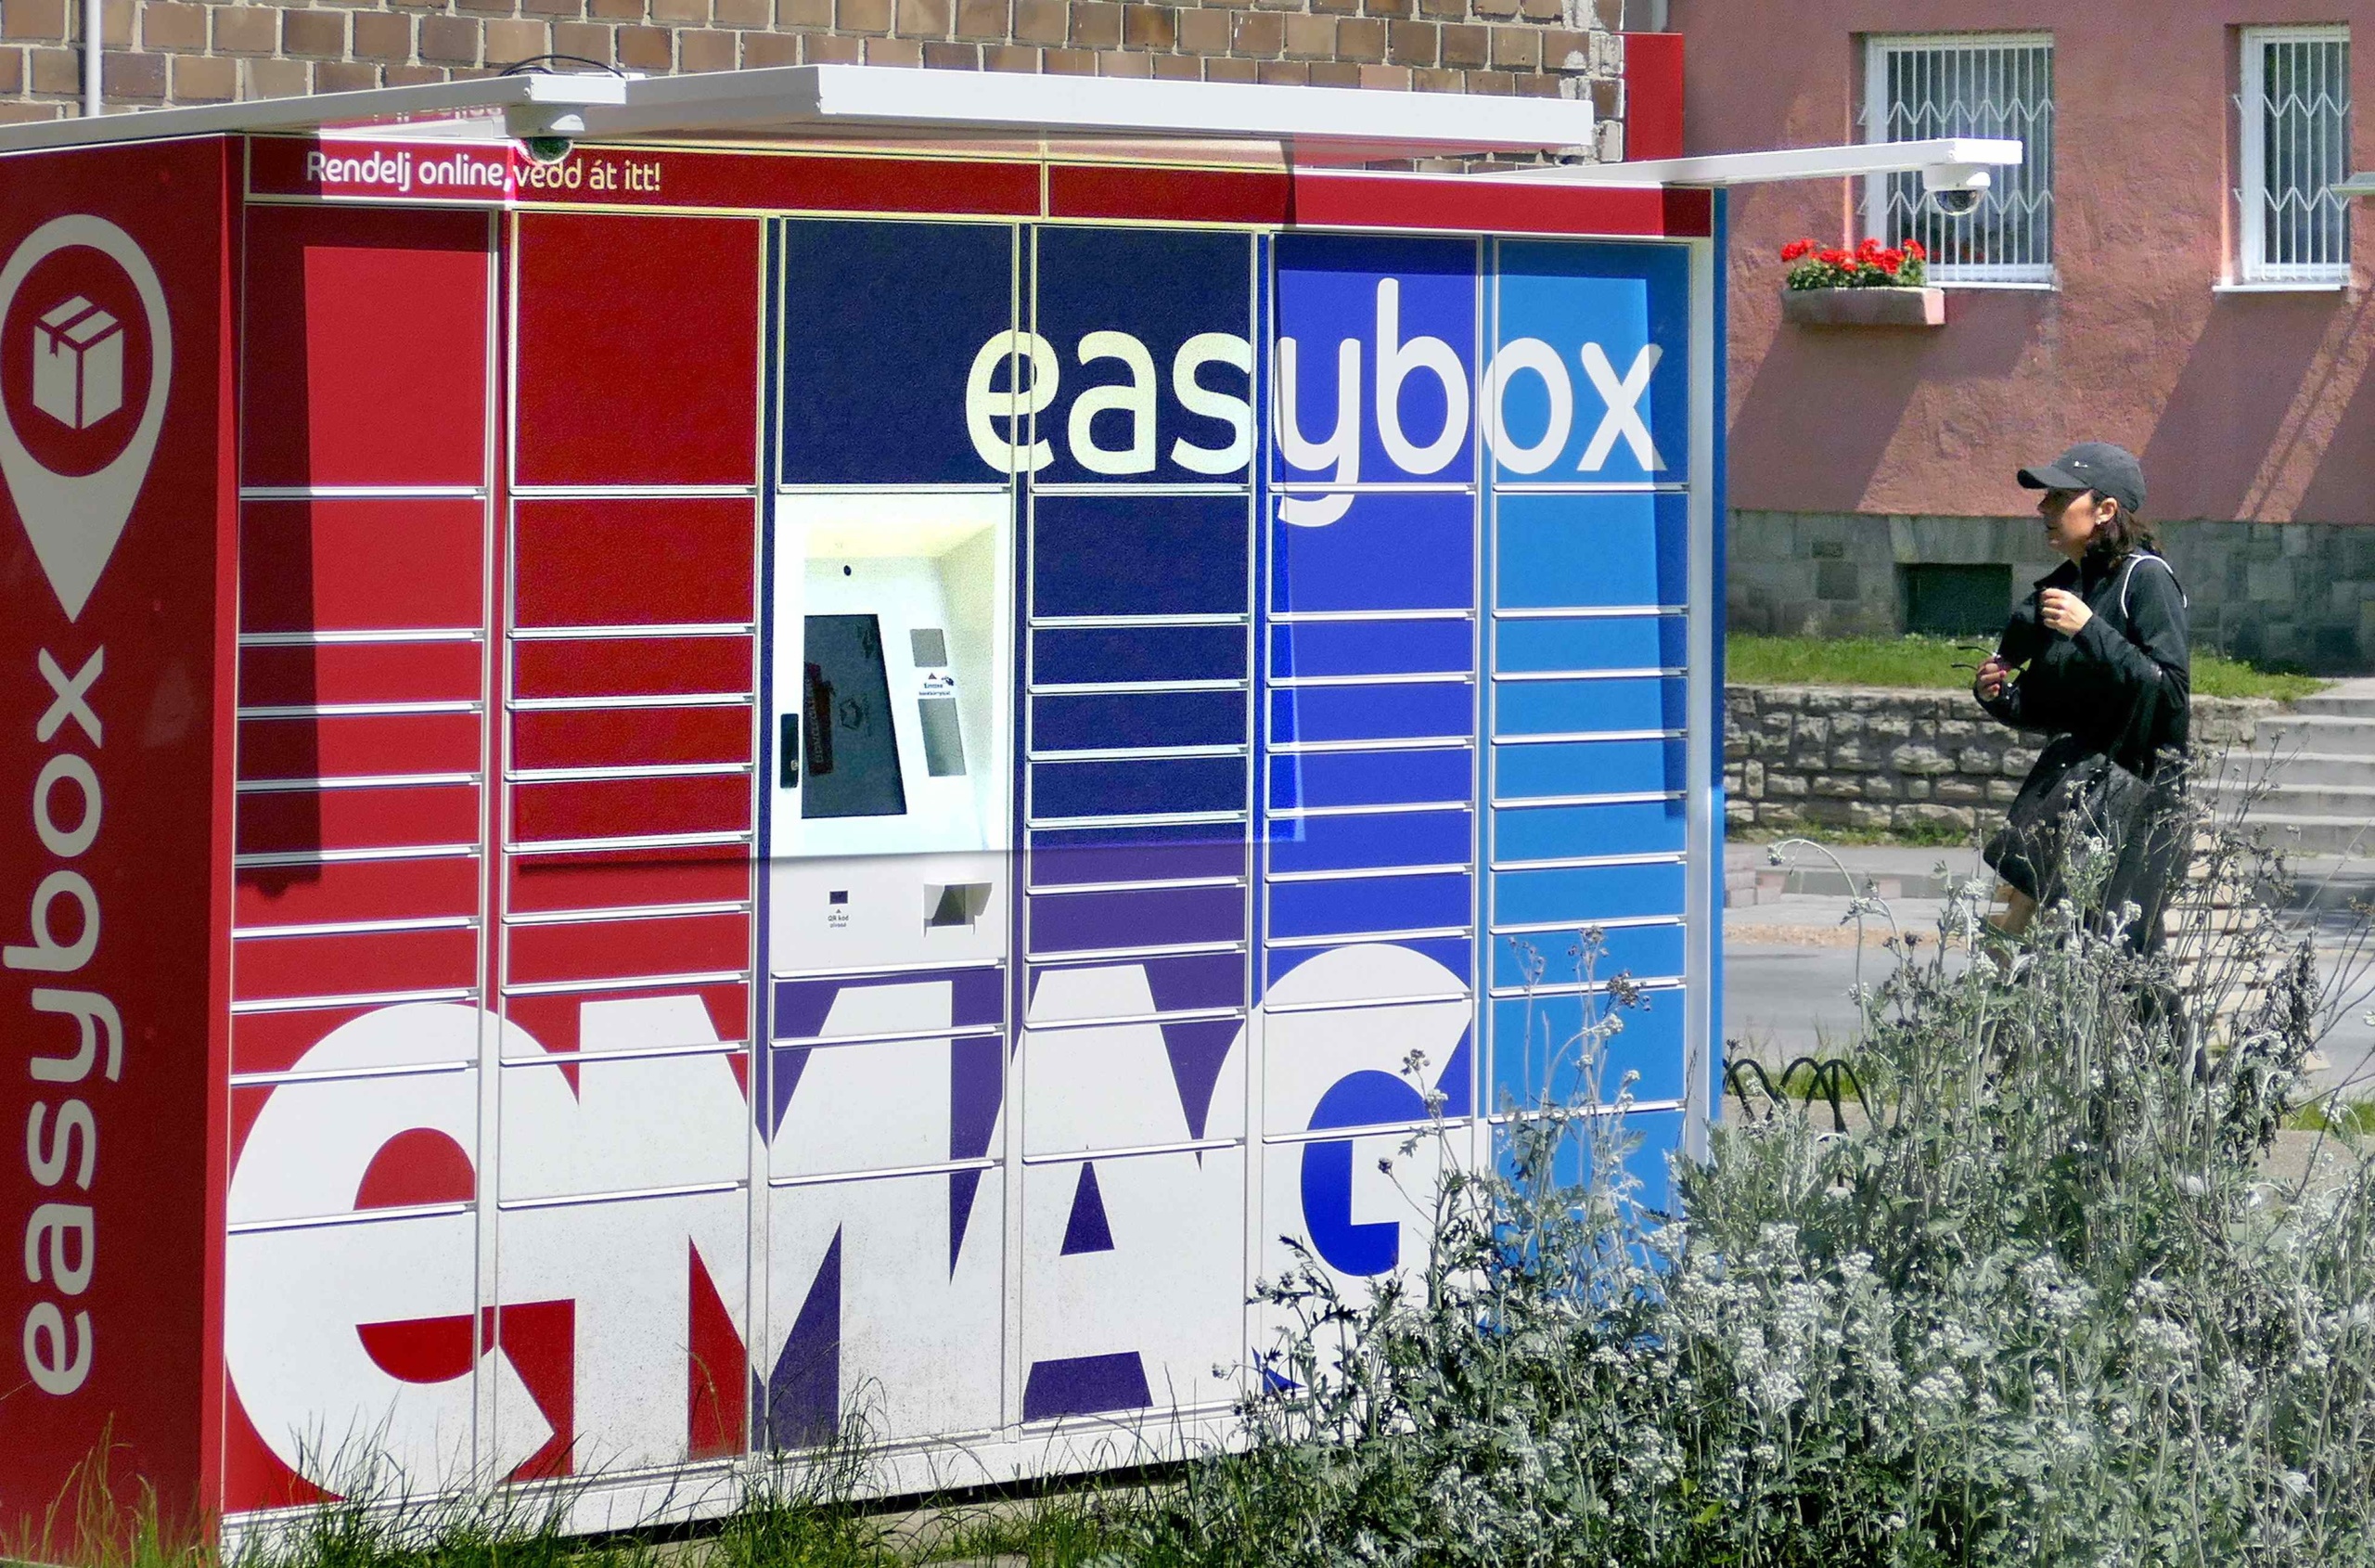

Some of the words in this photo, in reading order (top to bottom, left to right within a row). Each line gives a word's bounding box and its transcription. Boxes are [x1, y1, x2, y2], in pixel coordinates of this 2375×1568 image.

[306, 151, 410, 192] Rendelj
[418, 156, 514, 192] online,
[513, 158, 582, 188] vedd
[590, 160, 617, 189] át
[624, 160, 661, 191] itt!
[965, 277, 1668, 527] easybox
[3, 645, 123, 1396] easybox
